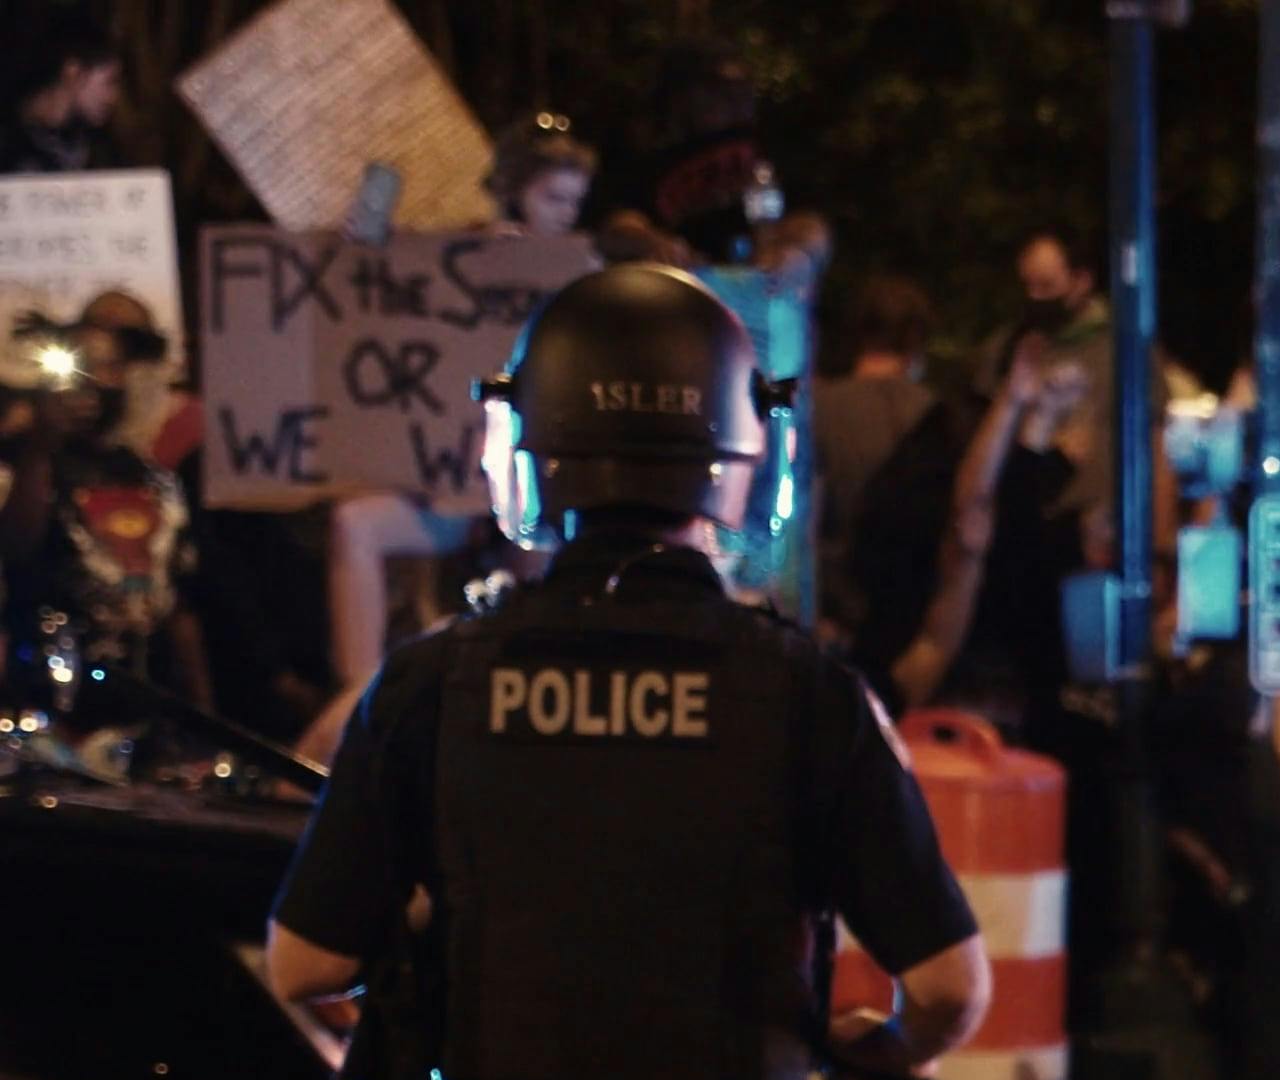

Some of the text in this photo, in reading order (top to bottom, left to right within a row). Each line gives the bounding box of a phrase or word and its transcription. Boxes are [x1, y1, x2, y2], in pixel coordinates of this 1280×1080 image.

[209, 238, 343, 333] FIX
[342, 337, 446, 416] OR
[590, 381, 702, 416] ISLER
[216, 403, 329, 485] WE
[489, 667, 711, 737] POLICE
